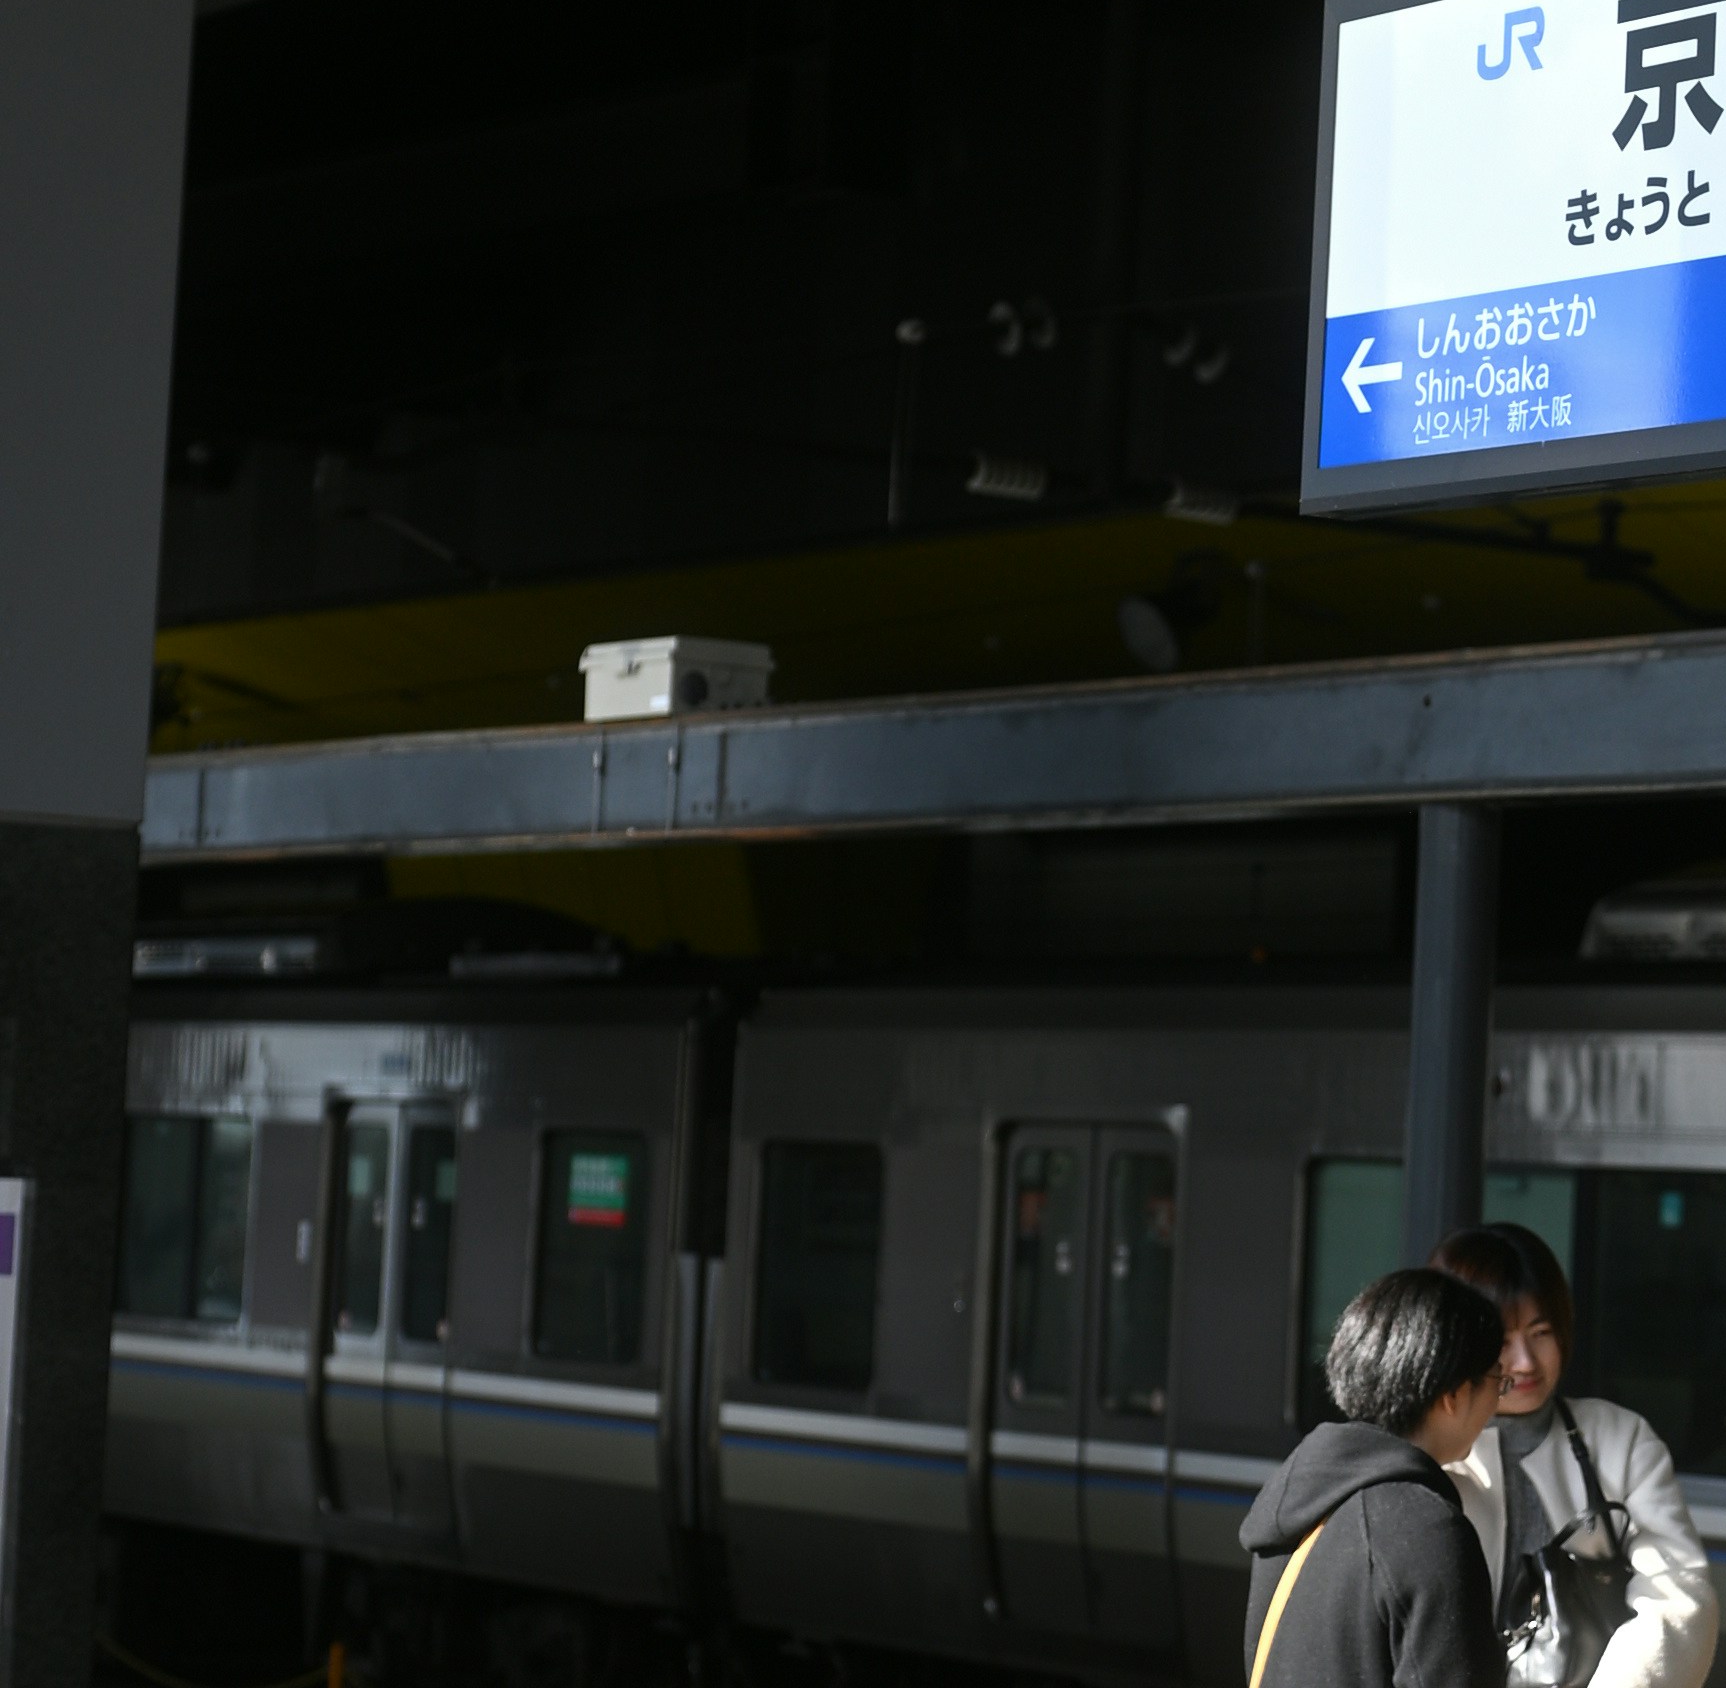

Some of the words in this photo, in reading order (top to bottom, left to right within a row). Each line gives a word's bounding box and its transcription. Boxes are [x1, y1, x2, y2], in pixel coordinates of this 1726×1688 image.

[1476, 7, 1547, 82] JR
[1564, 169, 1713, 247] きょうと
[1417, 292, 1597, 360] しんおおさか
[1415, 354, 1550, 407] Shin-Ōsaka
[1412, 403, 1491, 445] 신오사카
[1506, 393, 1573, 434] 新大阪
